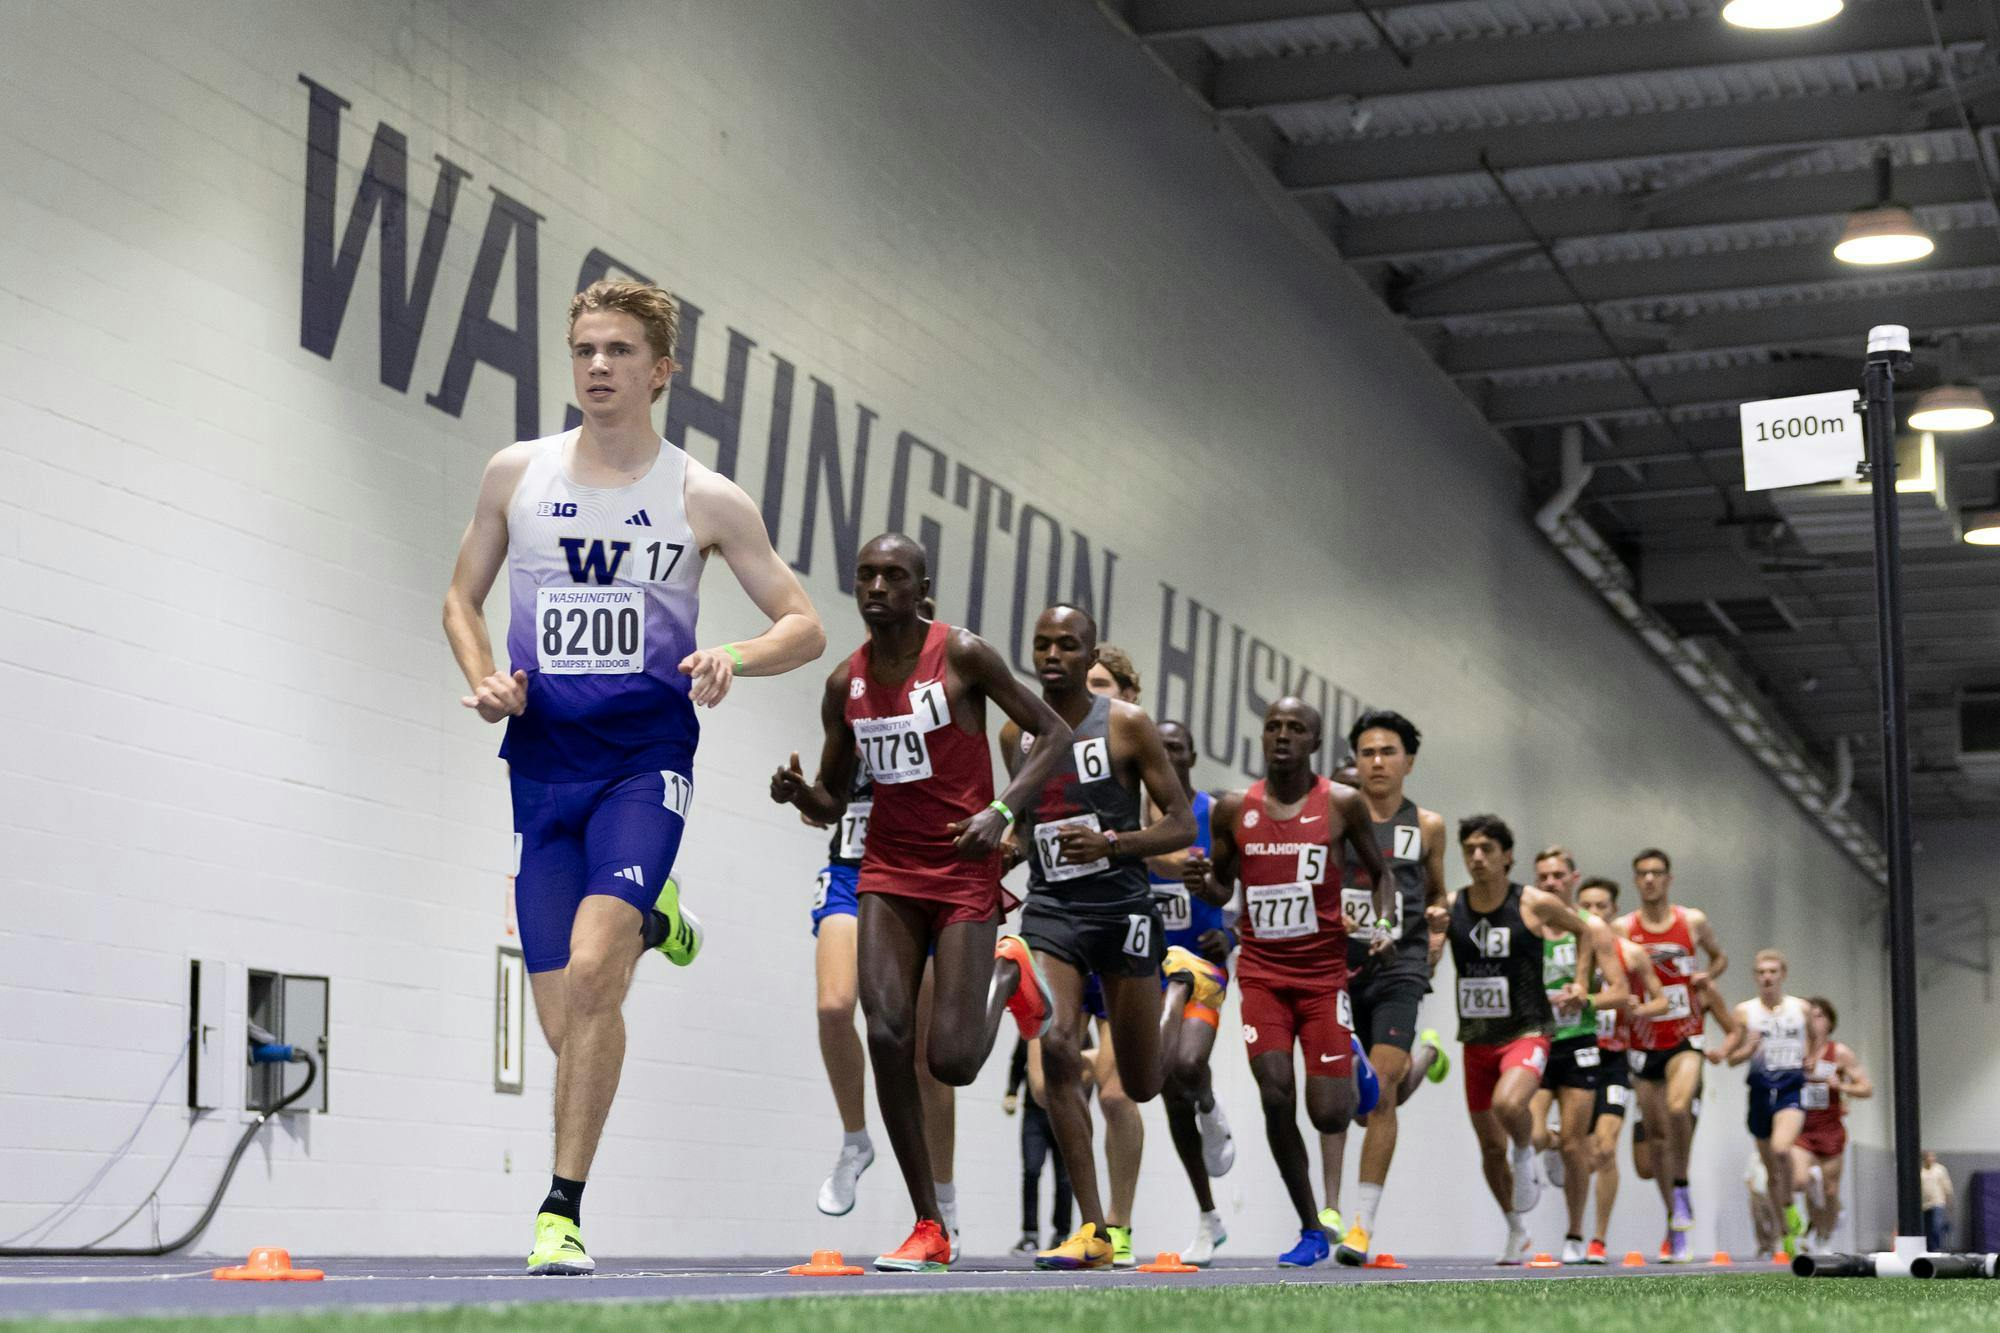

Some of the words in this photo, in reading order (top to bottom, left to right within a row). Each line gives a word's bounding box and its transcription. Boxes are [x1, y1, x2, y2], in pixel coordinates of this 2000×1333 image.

[1756, 416, 1844, 442] 1600m
[559, 537, 631, 585] W
[646, 541, 685, 581] 17
[549, 592, 633, 603] WASHINGTON
[543, 608, 639, 656] 8200
[551, 660, 592, 668] DEMPSEY
[595, 659, 630, 668] INDOOR
[921, 689, 941, 726] 1
[860, 731, 924, 770] 7779
[1084, 742, 1102, 778] 6
[671, 775, 690, 815] 17
[1245, 843, 1314, 856] OKLAHOM
[1400, 829, 1414, 855] 7
[1305, 848, 1321, 880] 5
[1251, 896, 1309, 927] 7777
[1133, 919, 1146, 953] 6
[1463, 988, 1505, 1008] 7821
